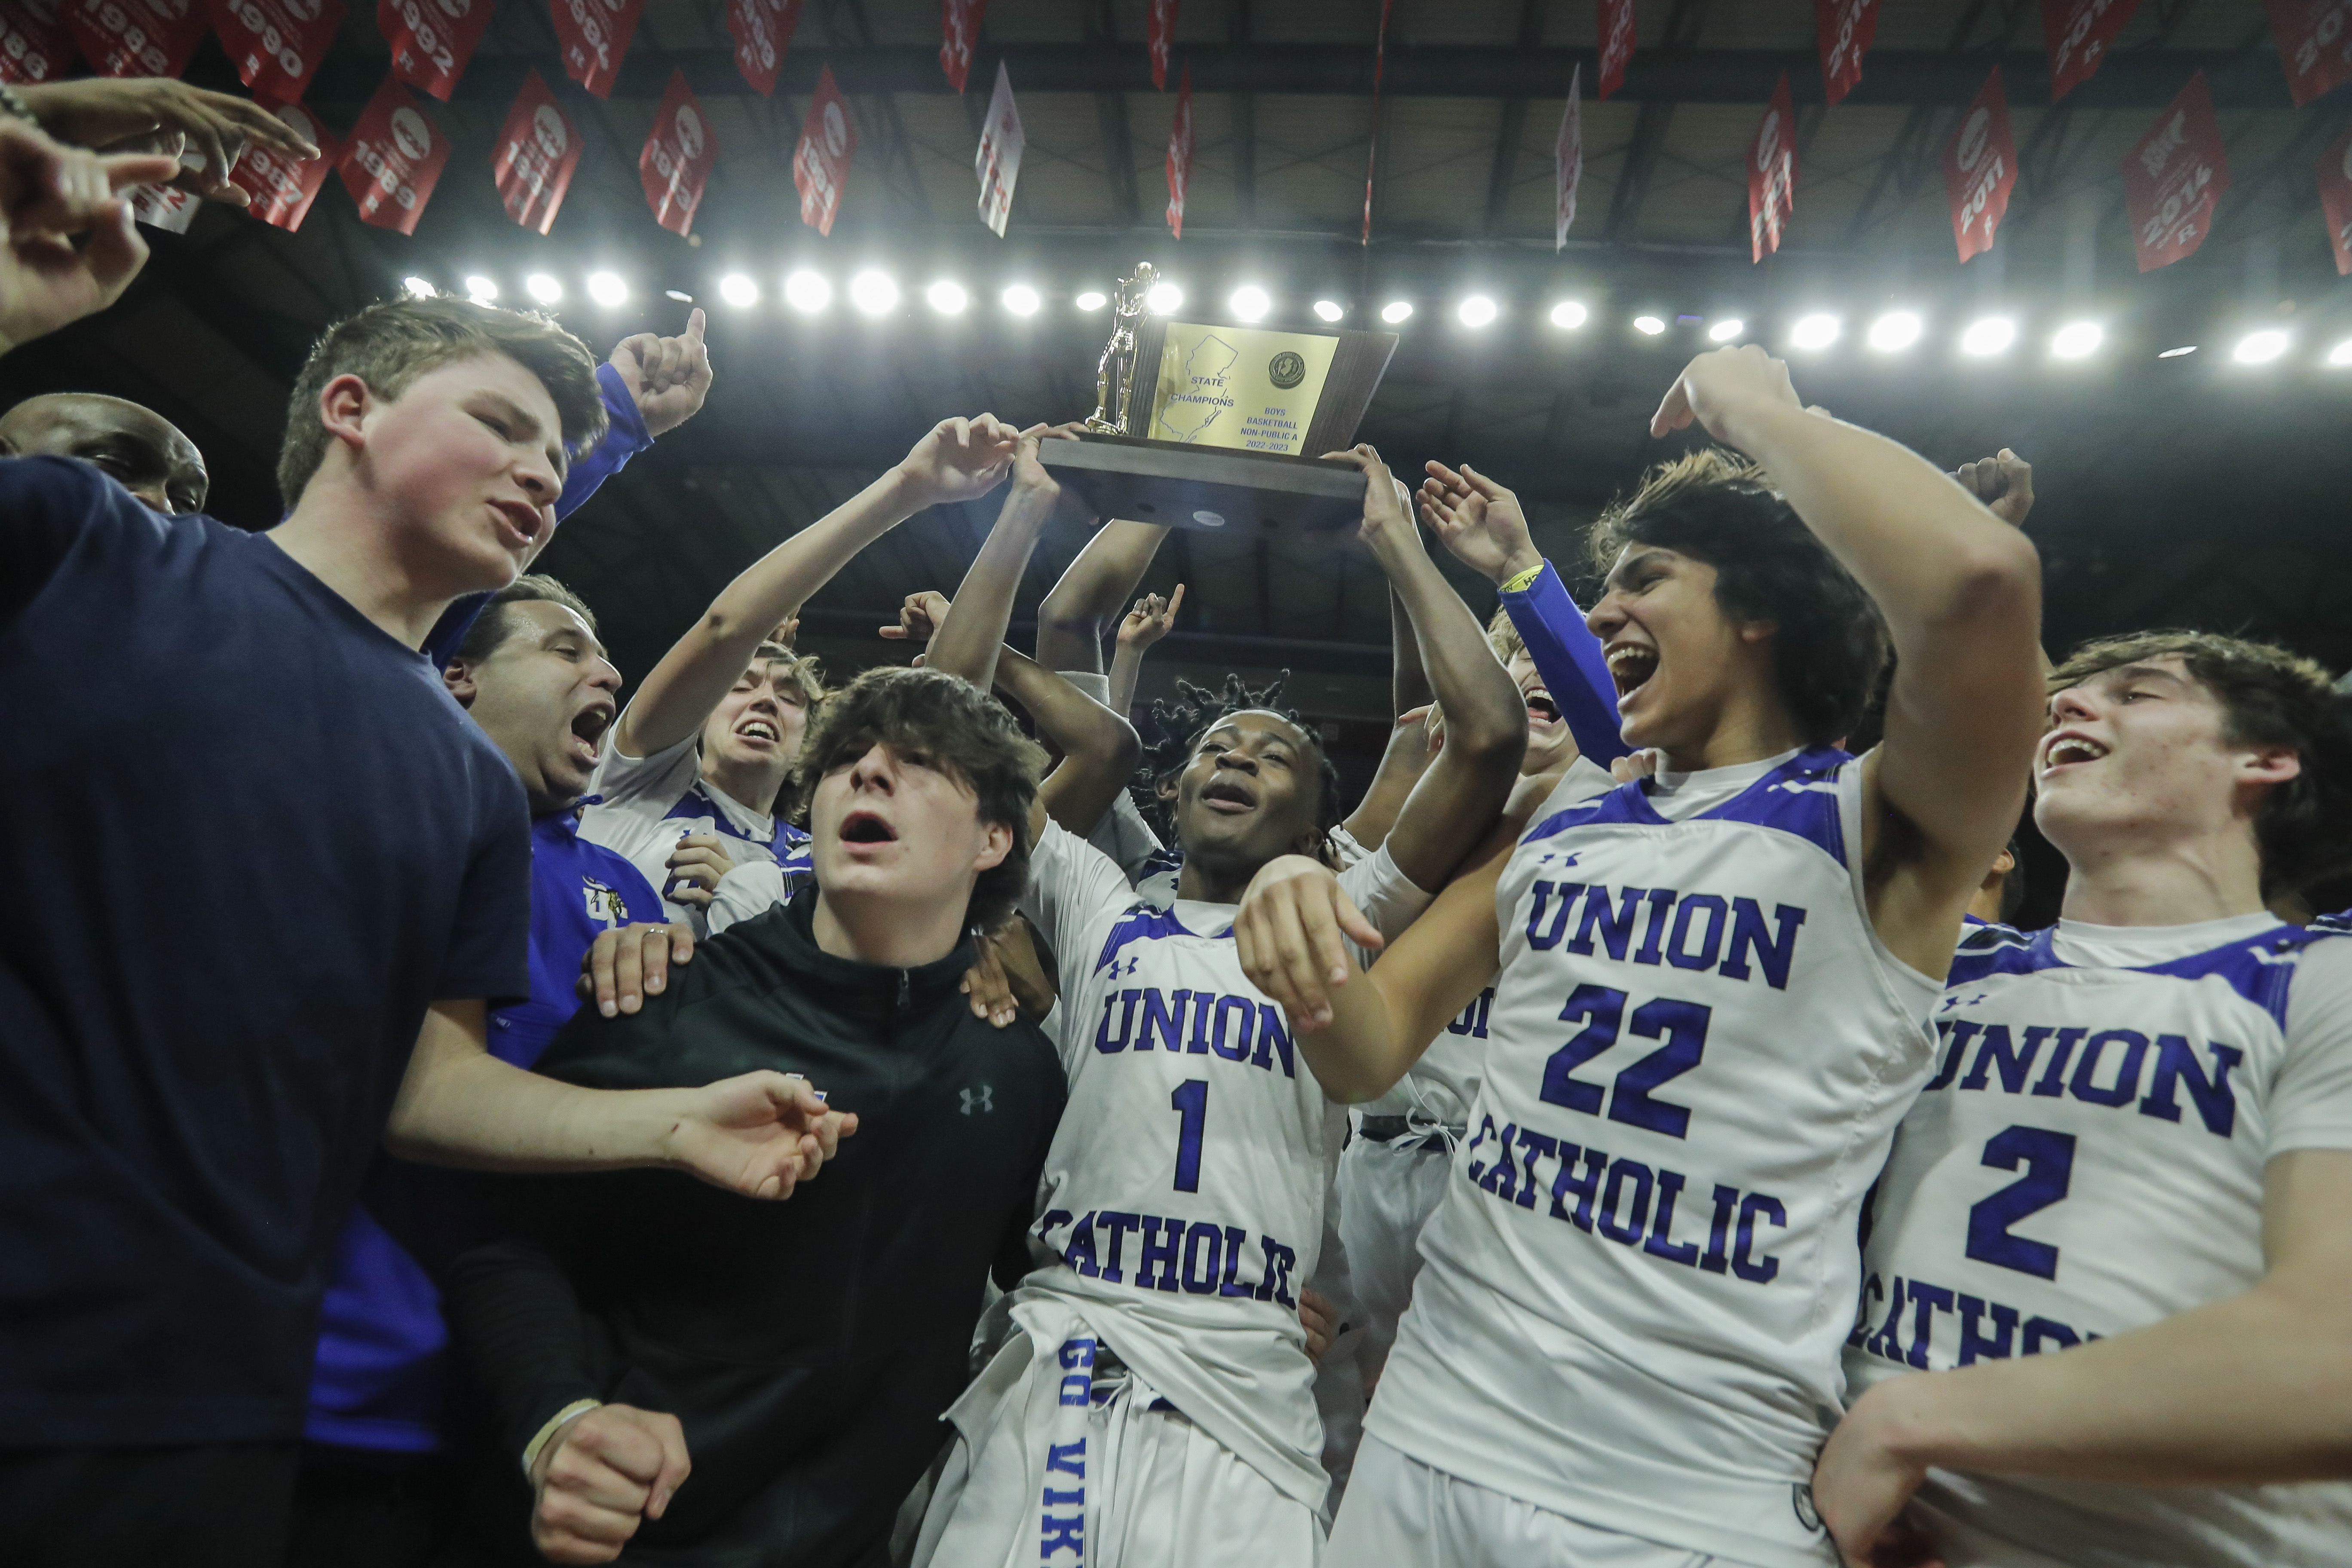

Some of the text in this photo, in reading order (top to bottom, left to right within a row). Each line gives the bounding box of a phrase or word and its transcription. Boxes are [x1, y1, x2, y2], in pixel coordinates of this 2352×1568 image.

[355, 140, 416, 210] 1989
[1170, 393, 1234, 407] CHAMPIONS
[1191, 376, 1224, 387] STATE
[1246, 416, 1297, 429] BASKETBALL
[1265, 407, 1286, 416] BOYS
[1240, 428, 1290, 440] NON-PUBLIC
[1246, 440, 1289, 451] 2022-2023
[1526, 880, 1807, 991] UNION
[1094, 988, 1296, 1080] UNION
[1539, 982, 1712, 1140] 22
[1922, 1019, 2244, 1139] UNION
[1170, 1078, 1209, 1194] 1
[1468, 1112, 1787, 1285] CATHOLIC
[1965, 1124, 2077, 1282] 2
[1040, 1436, 1087, 1568] VIK
